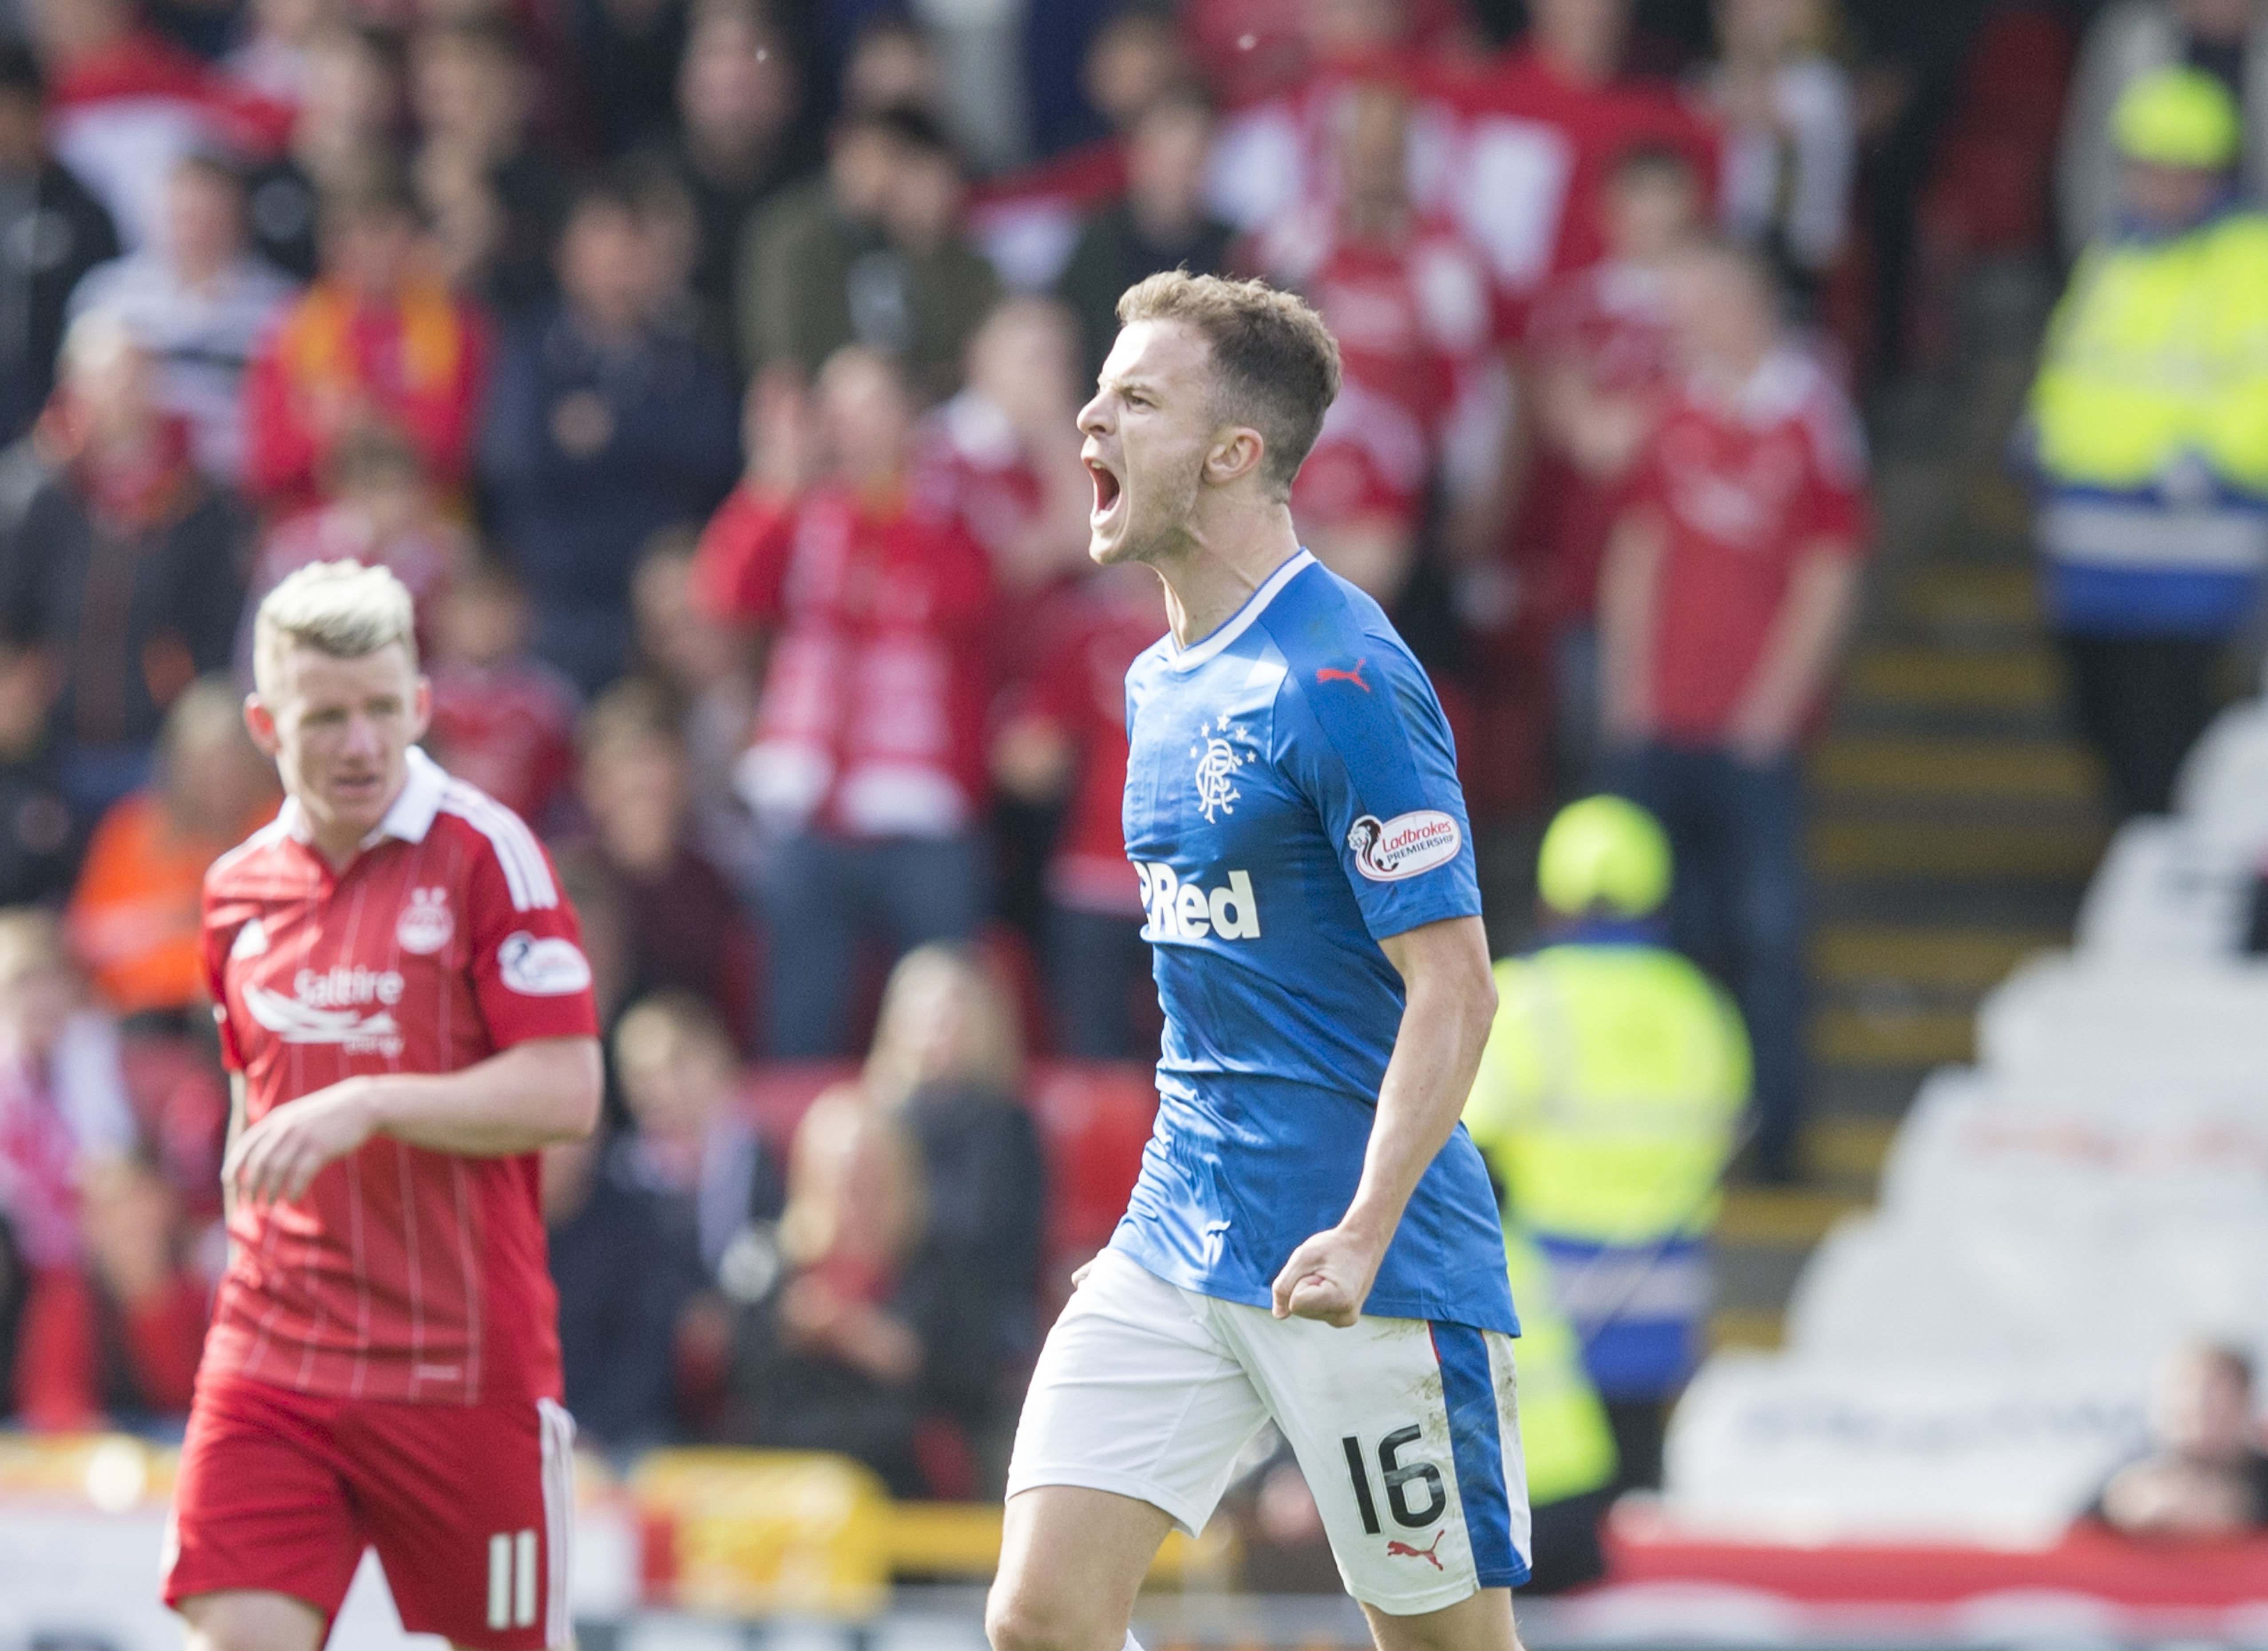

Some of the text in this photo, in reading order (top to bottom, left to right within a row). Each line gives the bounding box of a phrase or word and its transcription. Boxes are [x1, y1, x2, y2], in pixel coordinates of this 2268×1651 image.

[1382, 820, 1452, 853] Ladbrokes
[1387, 833, 1454, 863] PREMIERSHIP
[1342, 1423, 1448, 1534] 16
[487, 1528, 538, 1631] 11
